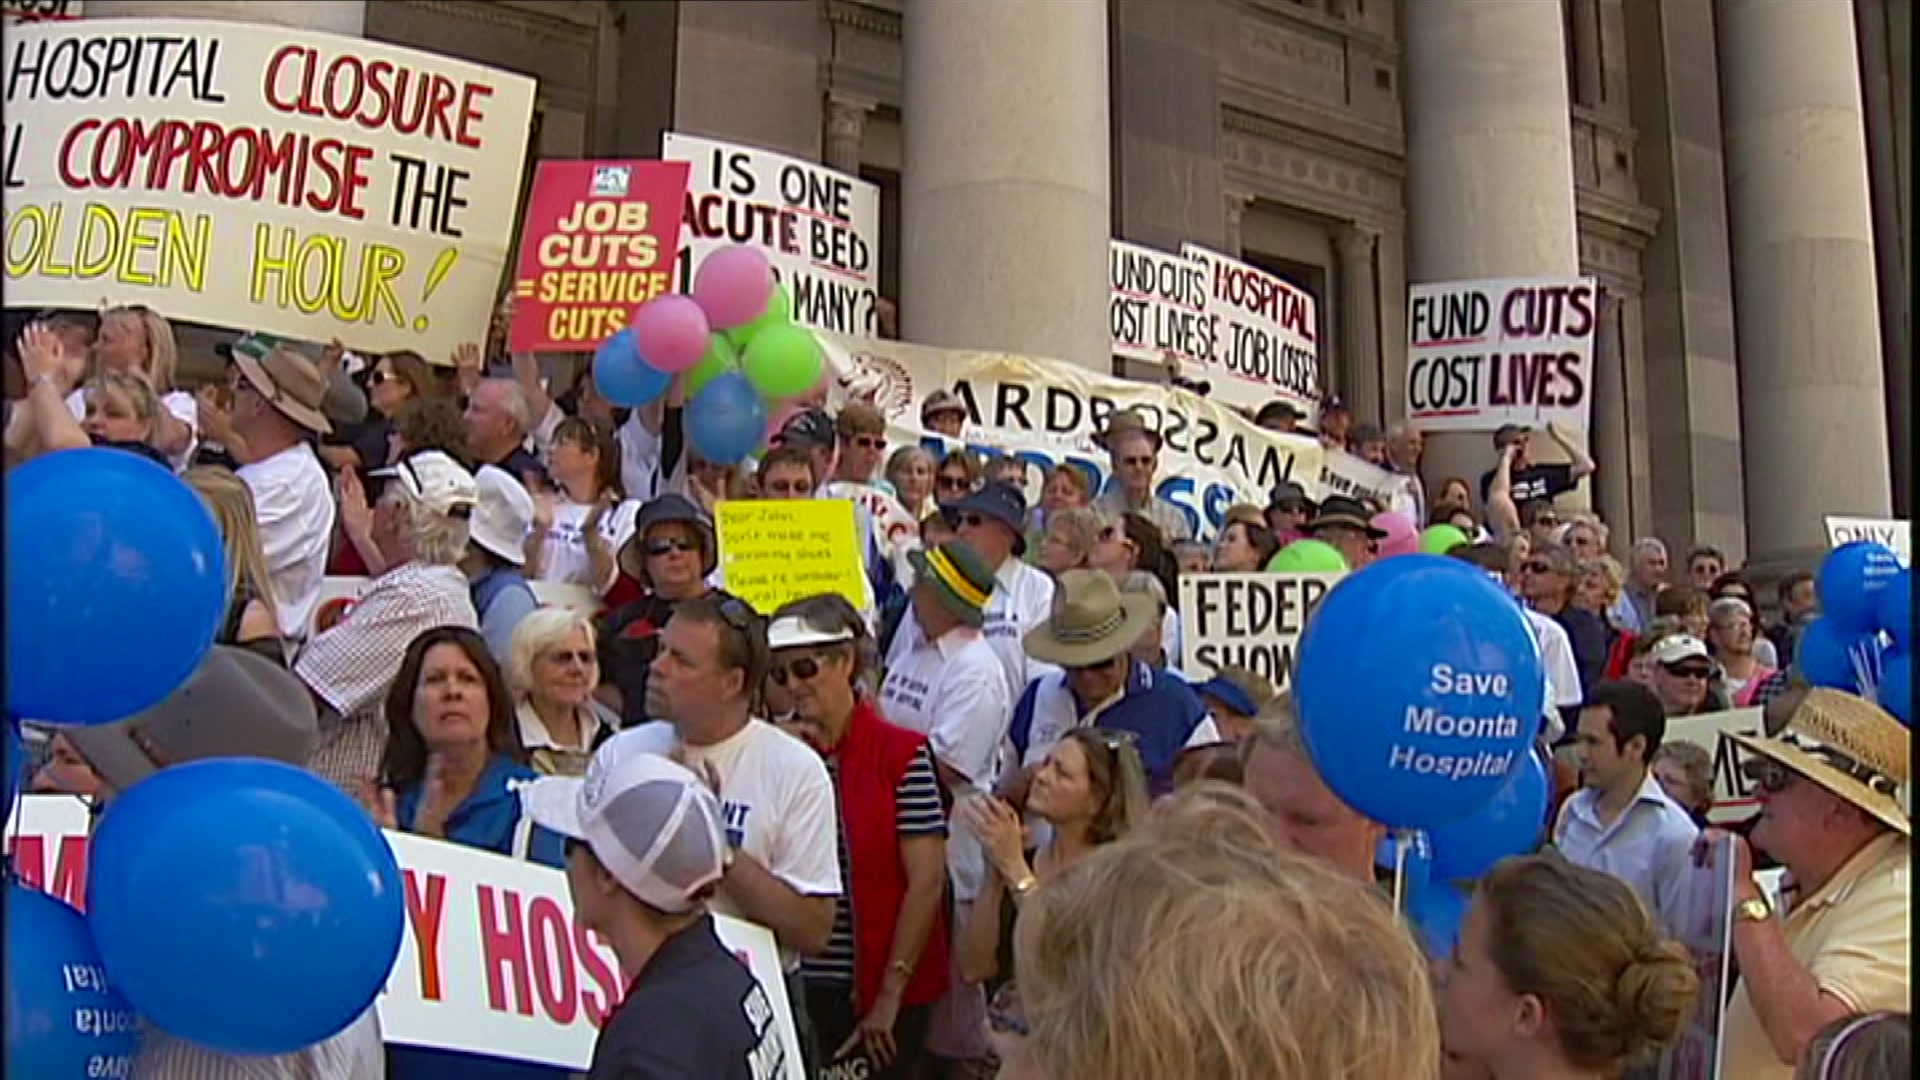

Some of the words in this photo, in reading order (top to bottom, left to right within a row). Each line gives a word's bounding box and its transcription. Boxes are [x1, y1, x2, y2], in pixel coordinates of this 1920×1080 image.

[9, 37, 225, 102] HOSPITAL
[264, 44, 495, 148] CLOSURE
[58, 117, 374, 220] COMPROMISE
[389, 153, 471, 238] THE
[711, 148, 757, 195] IS
[780, 164, 852, 222] ONE
[559, 201, 647, 232] JOB
[810, 219, 868, 271] BED
[6, 202, 212, 292] OLDEN
[538, 234, 660, 267] CUTS
[541, 272, 669, 304] SERVICE
[793, 269, 876, 338] MANY?
[1112, 248, 1156, 295] UND
[1158, 261, 1207, 311] CUTS
[1213, 260, 1314, 341] HOSPITAL
[548, 307, 628, 340] CUTS
[1110, 297, 1150, 344] OST
[1411, 290, 1490, 343] FUND
[1502, 286, 1593, 338] CUTS
[1224, 320, 1270, 379] JOB
[1409, 355, 1482, 410] COST
[1489, 351, 1584, 408] LIVES
[1196, 578, 1328, 637] FEDER
[1430, 663, 1509, 698] Save
[1404, 704, 1519, 738] Moonta
[1389, 744, 1514, 782] Hospital
[477, 883, 630, 1030] HOS
